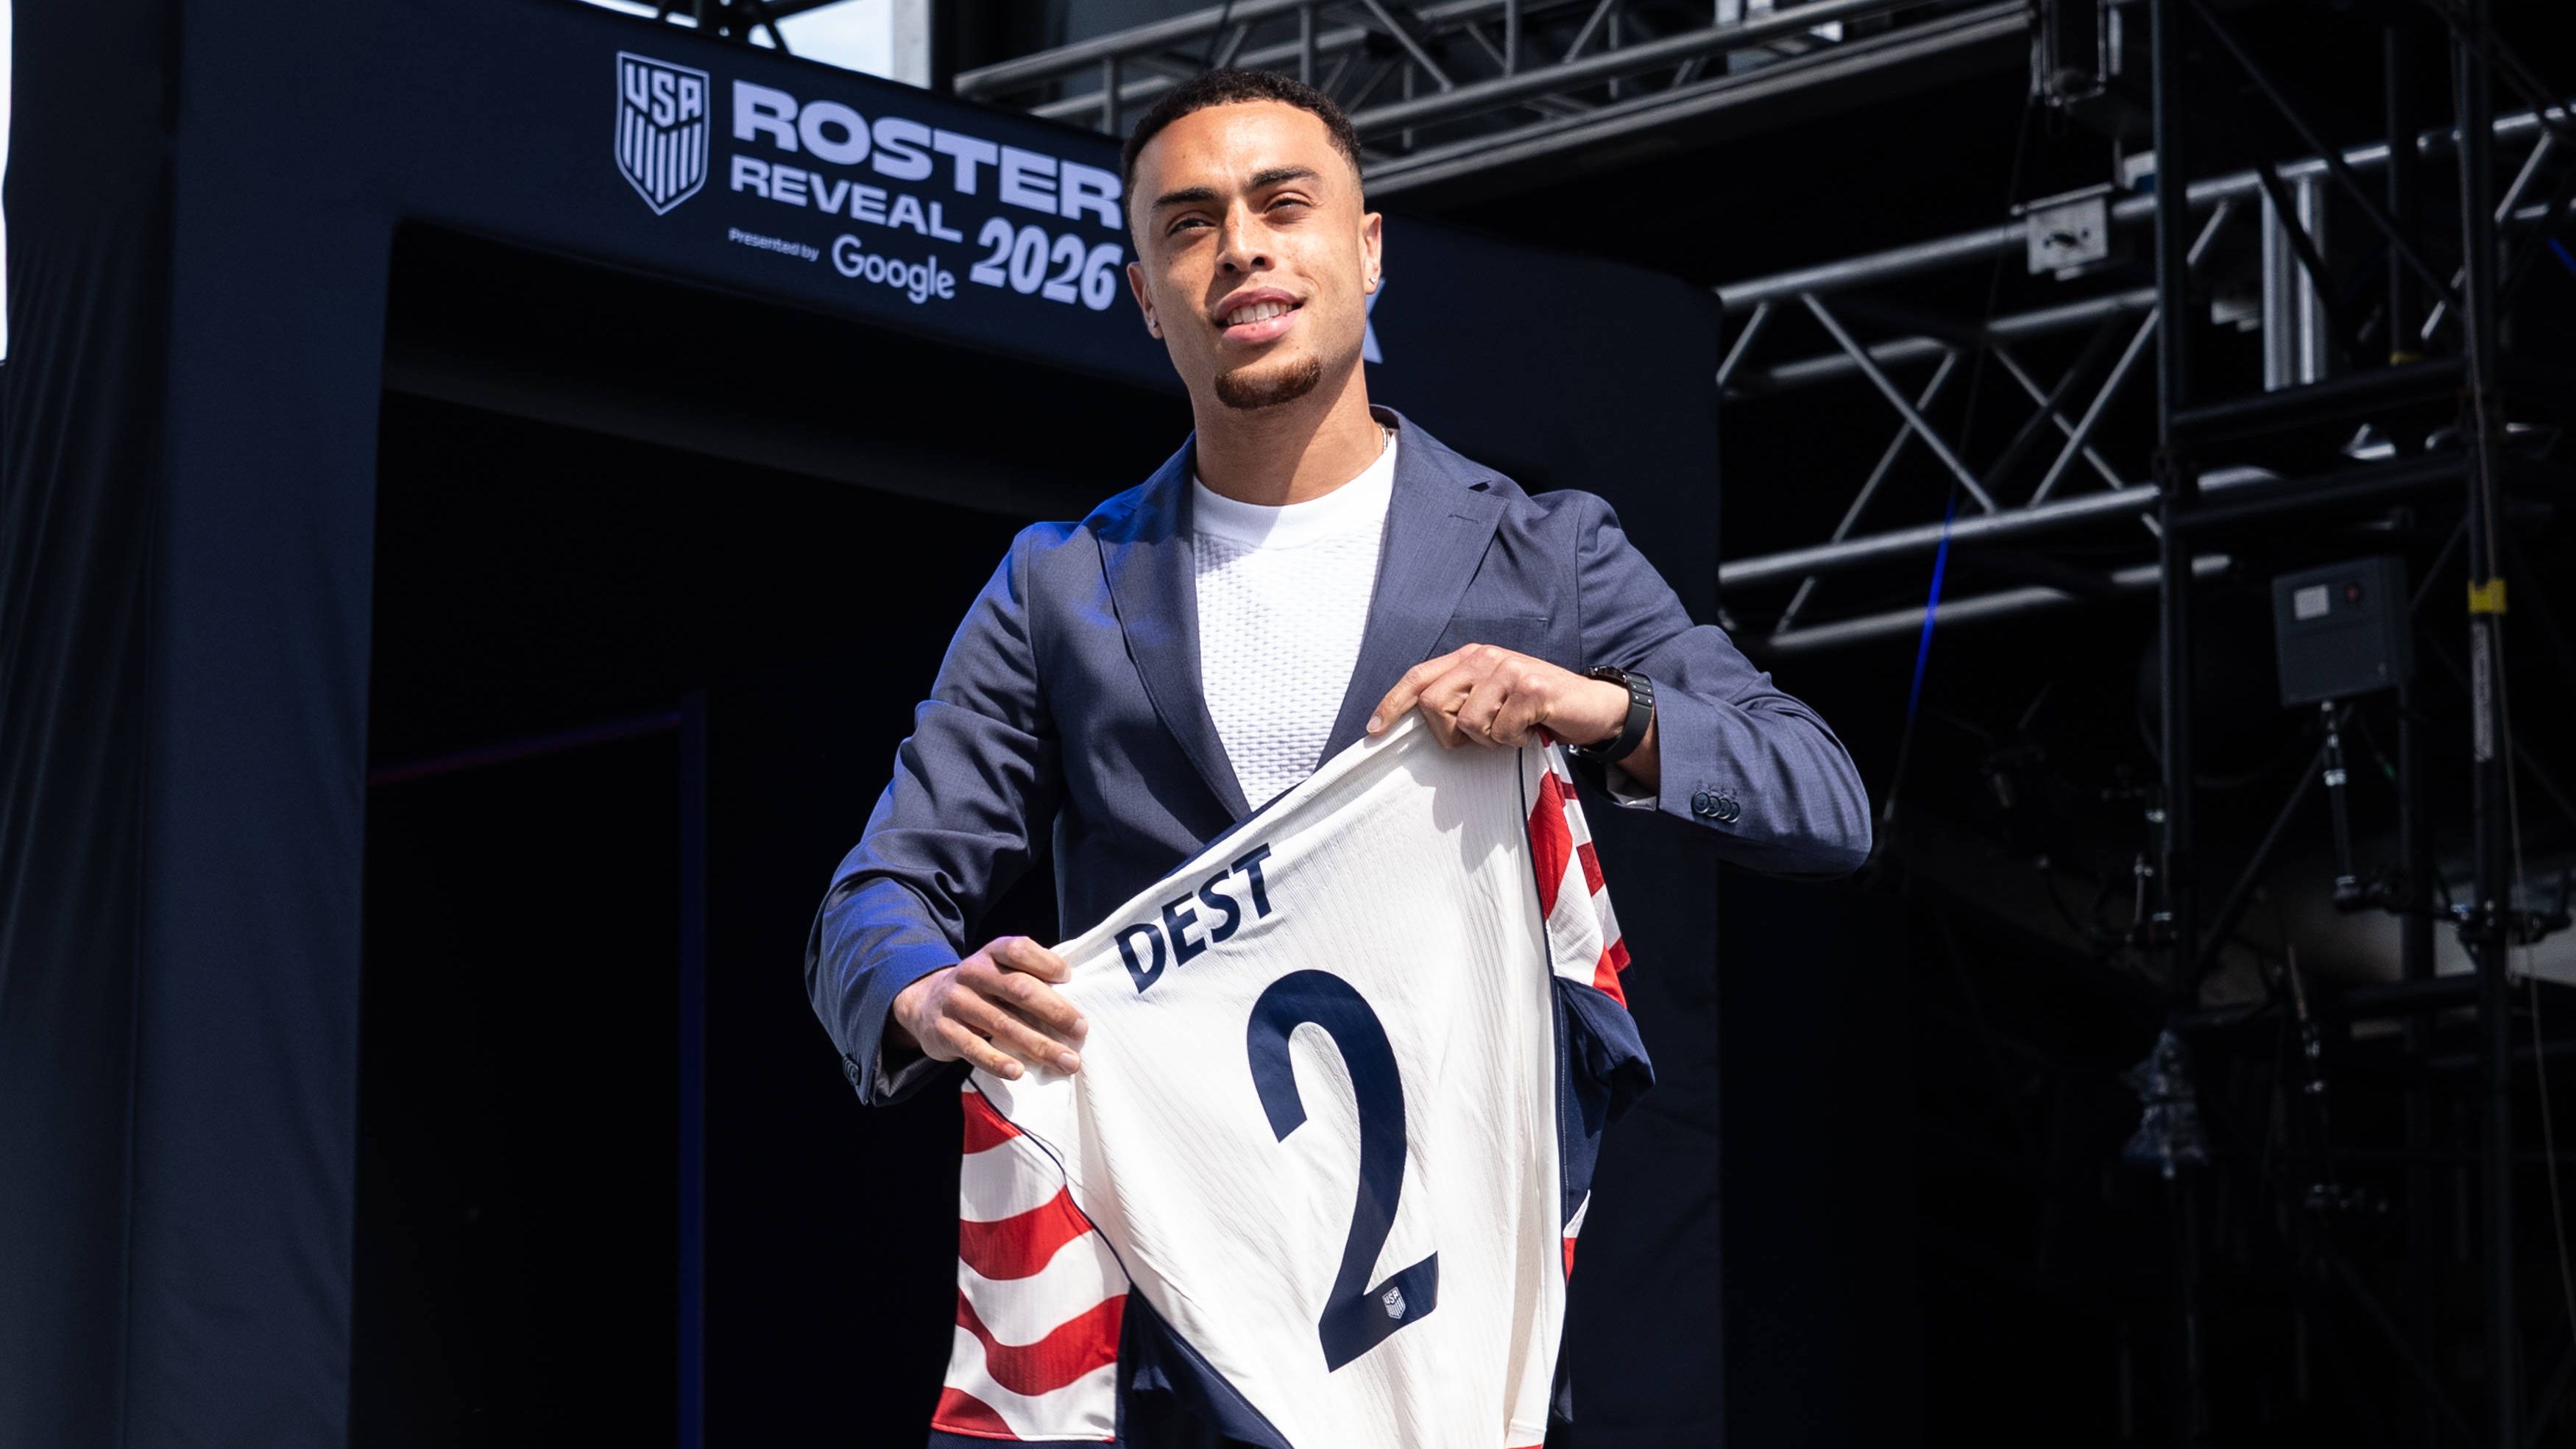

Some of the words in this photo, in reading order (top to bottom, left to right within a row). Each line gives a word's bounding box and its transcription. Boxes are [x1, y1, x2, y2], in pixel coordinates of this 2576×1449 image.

[624, 62, 702, 128] USA
[733, 79, 1123, 230] ROSTER
[731, 155, 963, 243] REVEAL
[729, 228, 801, 255] Presented
[801, 244, 819, 261] by
[831, 233, 955, 304] Google
[969, 216, 1124, 311] 2026
[1114, 842, 1273, 995] DEST
[1246, 968, 1439, 1373] 2
[1384, 1289, 1399, 1304] USA
